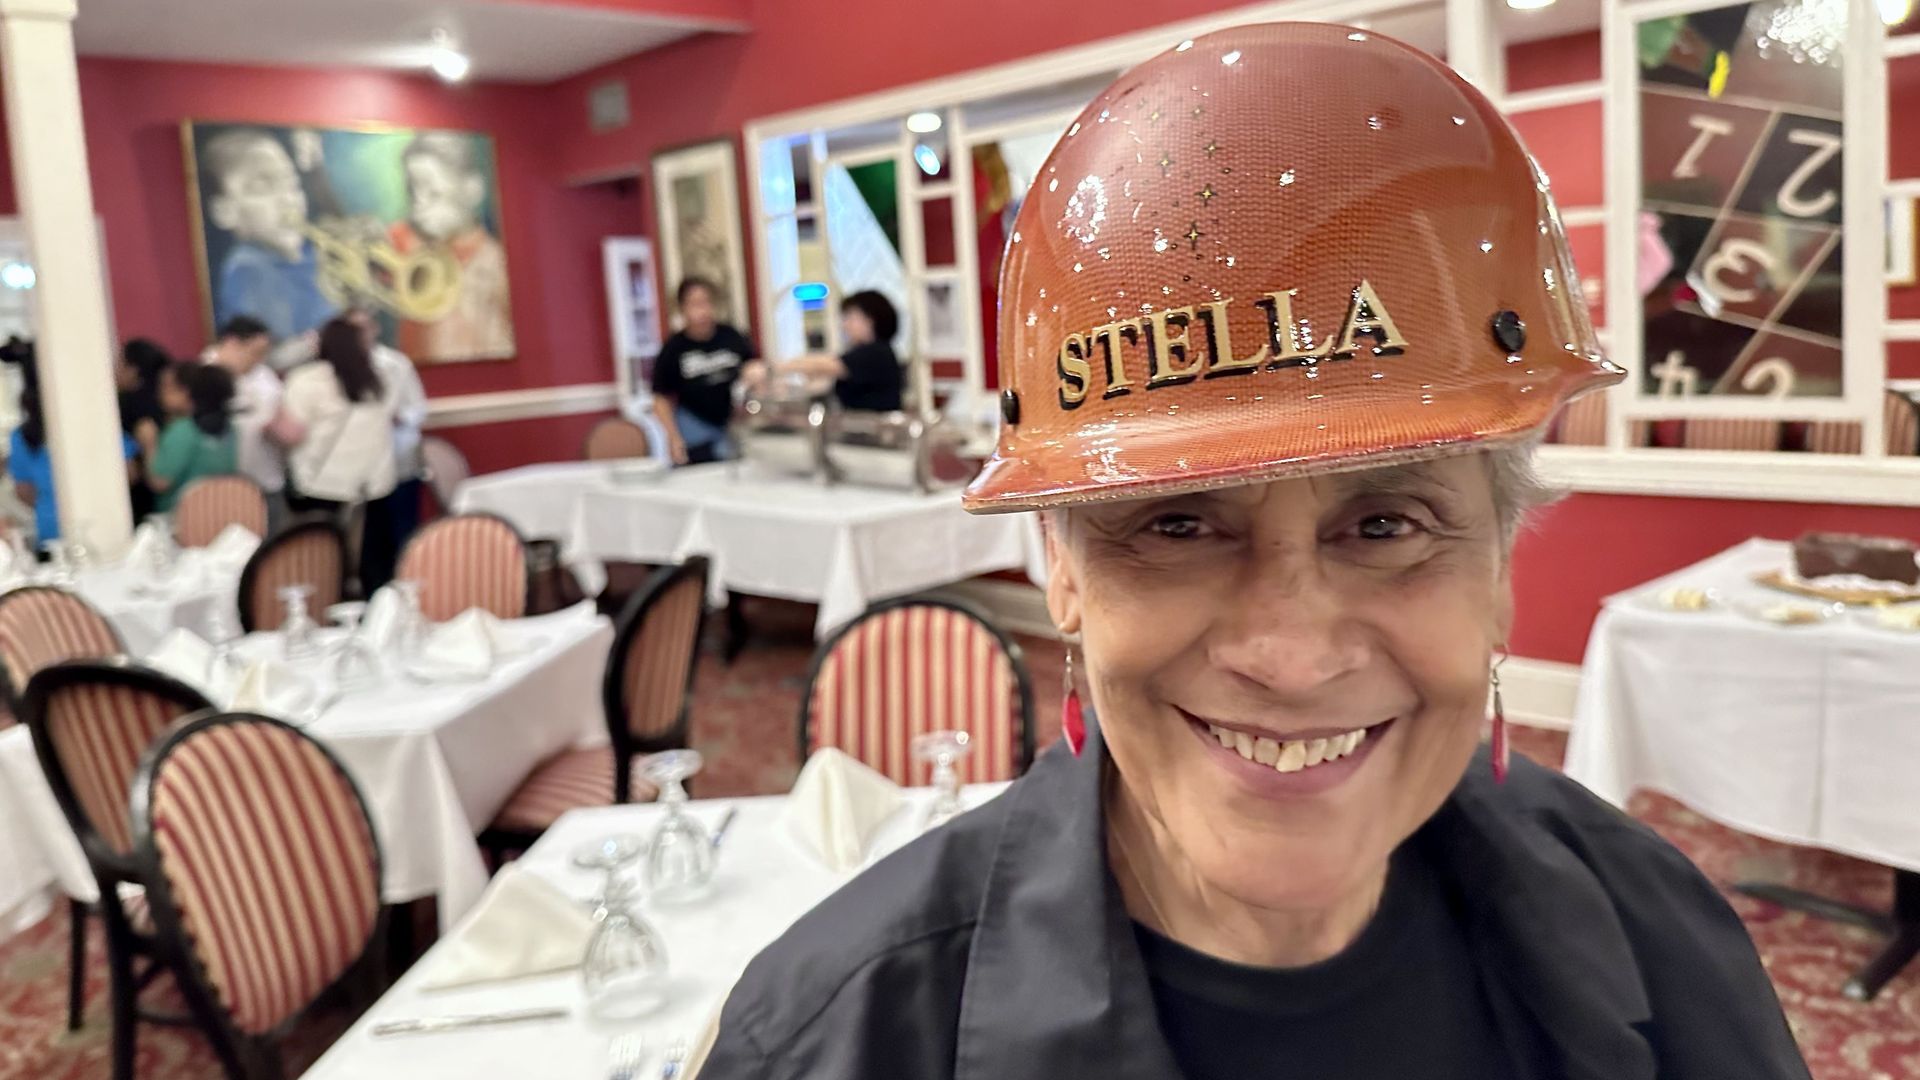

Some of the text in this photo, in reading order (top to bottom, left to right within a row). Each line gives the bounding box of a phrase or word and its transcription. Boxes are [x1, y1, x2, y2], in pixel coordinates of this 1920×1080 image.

[1776, 129, 1841, 217] 2
[1702, 238, 1776, 303] 3
[1057, 278, 1410, 410] STELLA
